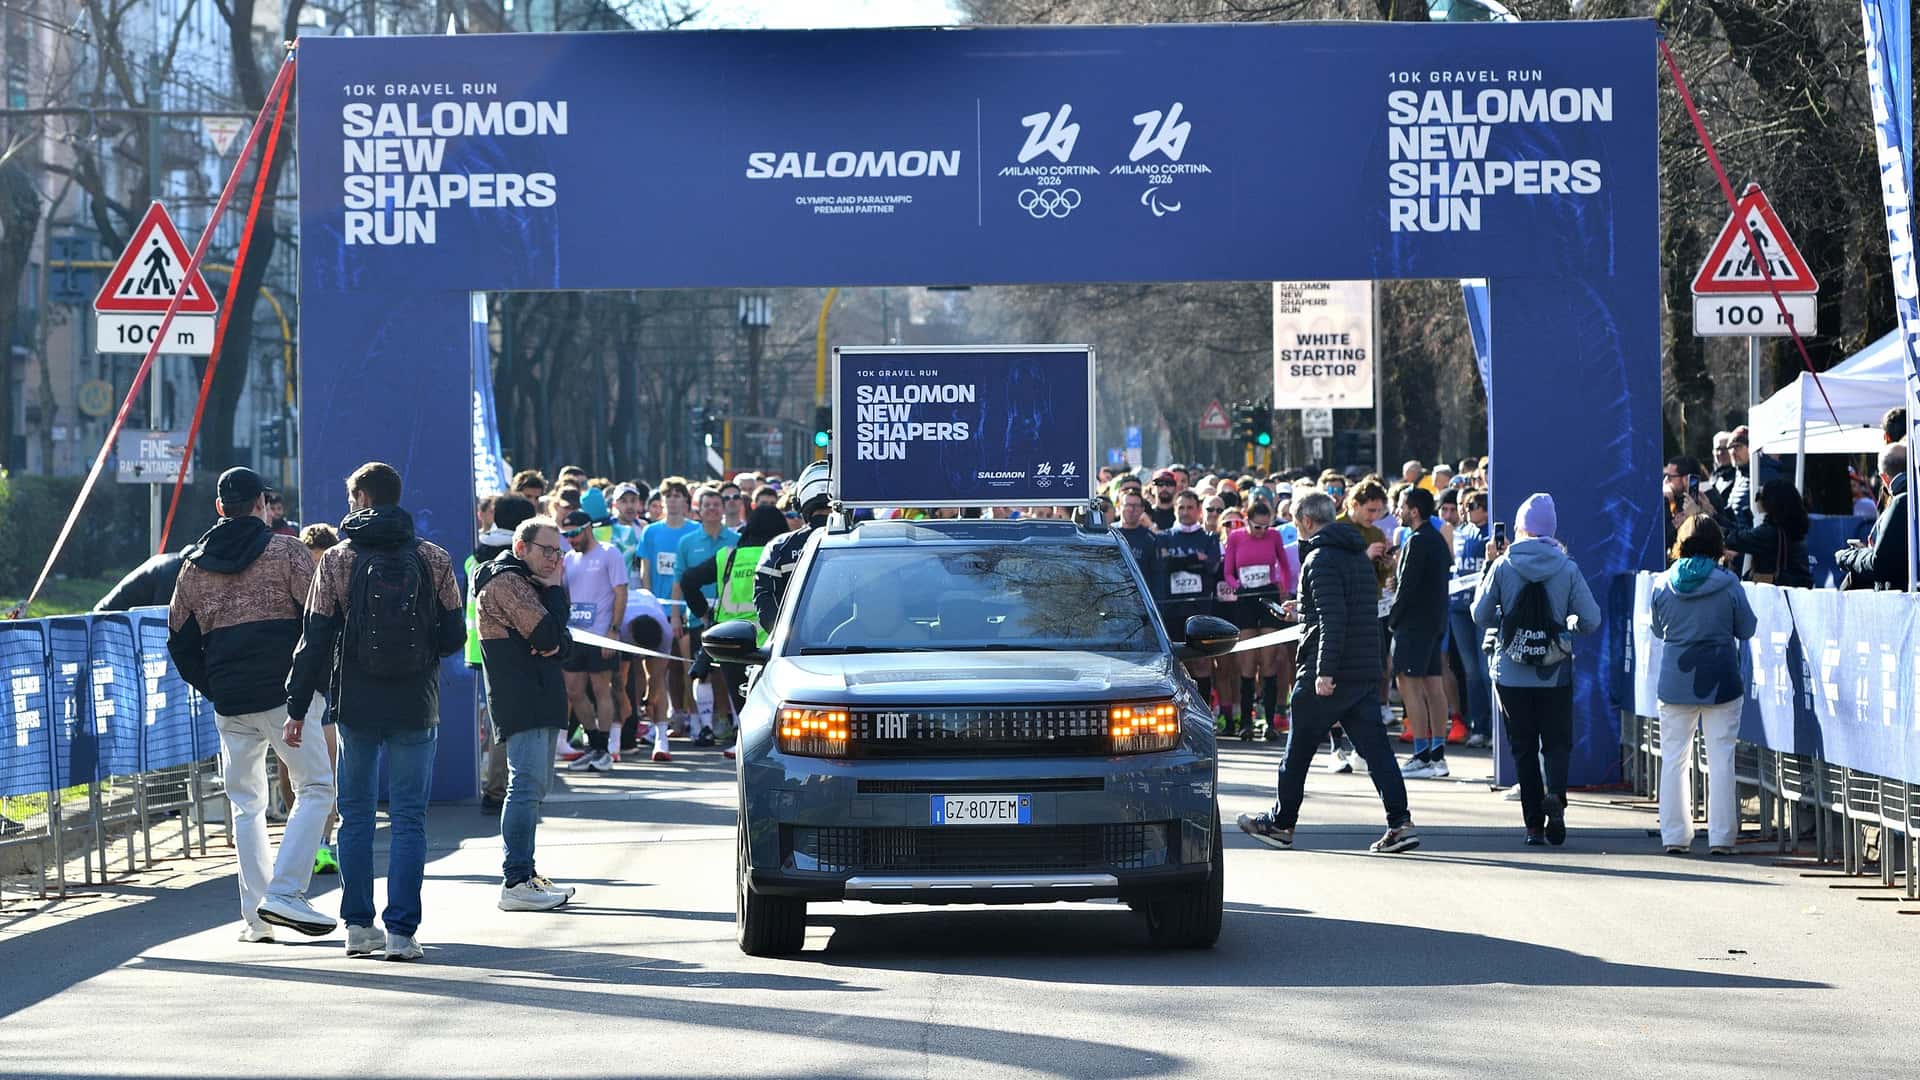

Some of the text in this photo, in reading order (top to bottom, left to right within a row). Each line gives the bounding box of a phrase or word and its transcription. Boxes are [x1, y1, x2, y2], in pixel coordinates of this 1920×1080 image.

[1388, 70, 1543, 83] 10K GRAVEL RUN
[343, 83, 497, 96] 10K GRAVEL RUN
[1387, 87, 1613, 125] SALOMON
[342, 100, 568, 137] SALOMON
[1388, 125, 1491, 160] NEW
[343, 138, 447, 173] NEW
[746, 150, 961, 179] SALOMON
[998, 165, 1101, 176] MILANO CORTINA
[1109, 164, 1212, 175] MILANO CORTINA
[1388, 159, 1602, 197] SHAPERS
[1037, 176, 1062, 185] 2026
[1149, 175, 1173, 184] 2026
[343, 172, 557, 210] SHAPERS
[795, 195, 913, 205] OLYMPIC AND PARALYMPIC
[814, 205, 894, 214] PREMIUM PARTNER
[1390, 197, 1481, 233] RUN
[344, 210, 436, 245] RUN
[1716, 306, 1764, 325] 100
[177, 332, 195, 344] m
[1296, 333, 1350, 345] WHITE
[1281, 349, 1366, 361] STARTING
[919, 369, 939, 377] RUN
[1290, 364, 1357, 377] SECTOR
[856, 384, 976, 404] SALOMON
[857, 404, 911, 423] NEW
[857, 422, 969, 441] SHAPERS
[140, 439, 171, 458] FINE
[857, 441, 906, 460] RUN
[977, 471, 1026, 479] SALOMON
[876, 712, 909, 739] FIAT
